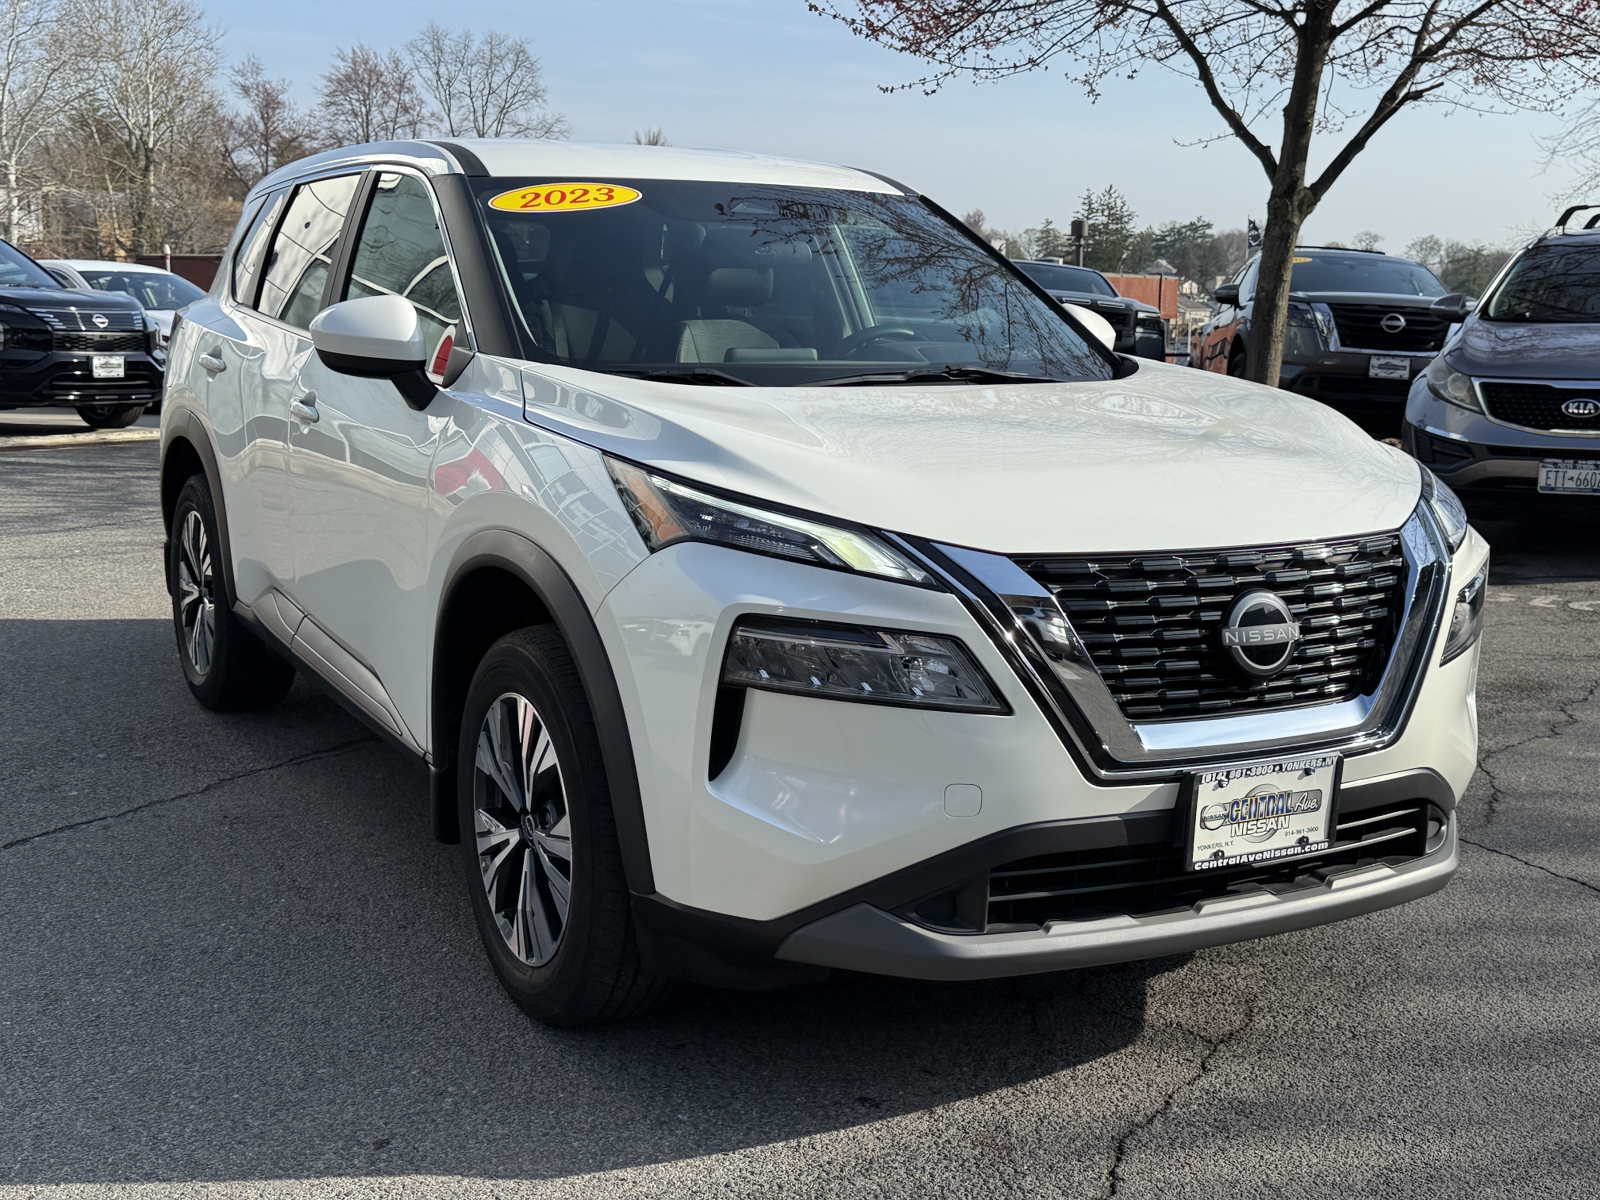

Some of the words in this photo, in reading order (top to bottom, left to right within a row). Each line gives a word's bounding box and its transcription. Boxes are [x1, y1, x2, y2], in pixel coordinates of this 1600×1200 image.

[519, 187, 615, 209] 2023
[1568, 402, 1595, 414] KIA
[1545, 470, 1568, 487] ETT
[1225, 626, 1299, 643] NISSAN
[1228, 789, 1293, 823] CENTRAL
[1203, 812, 1227, 821] NISSAN
[1230, 816, 1291, 837] NISSAN
